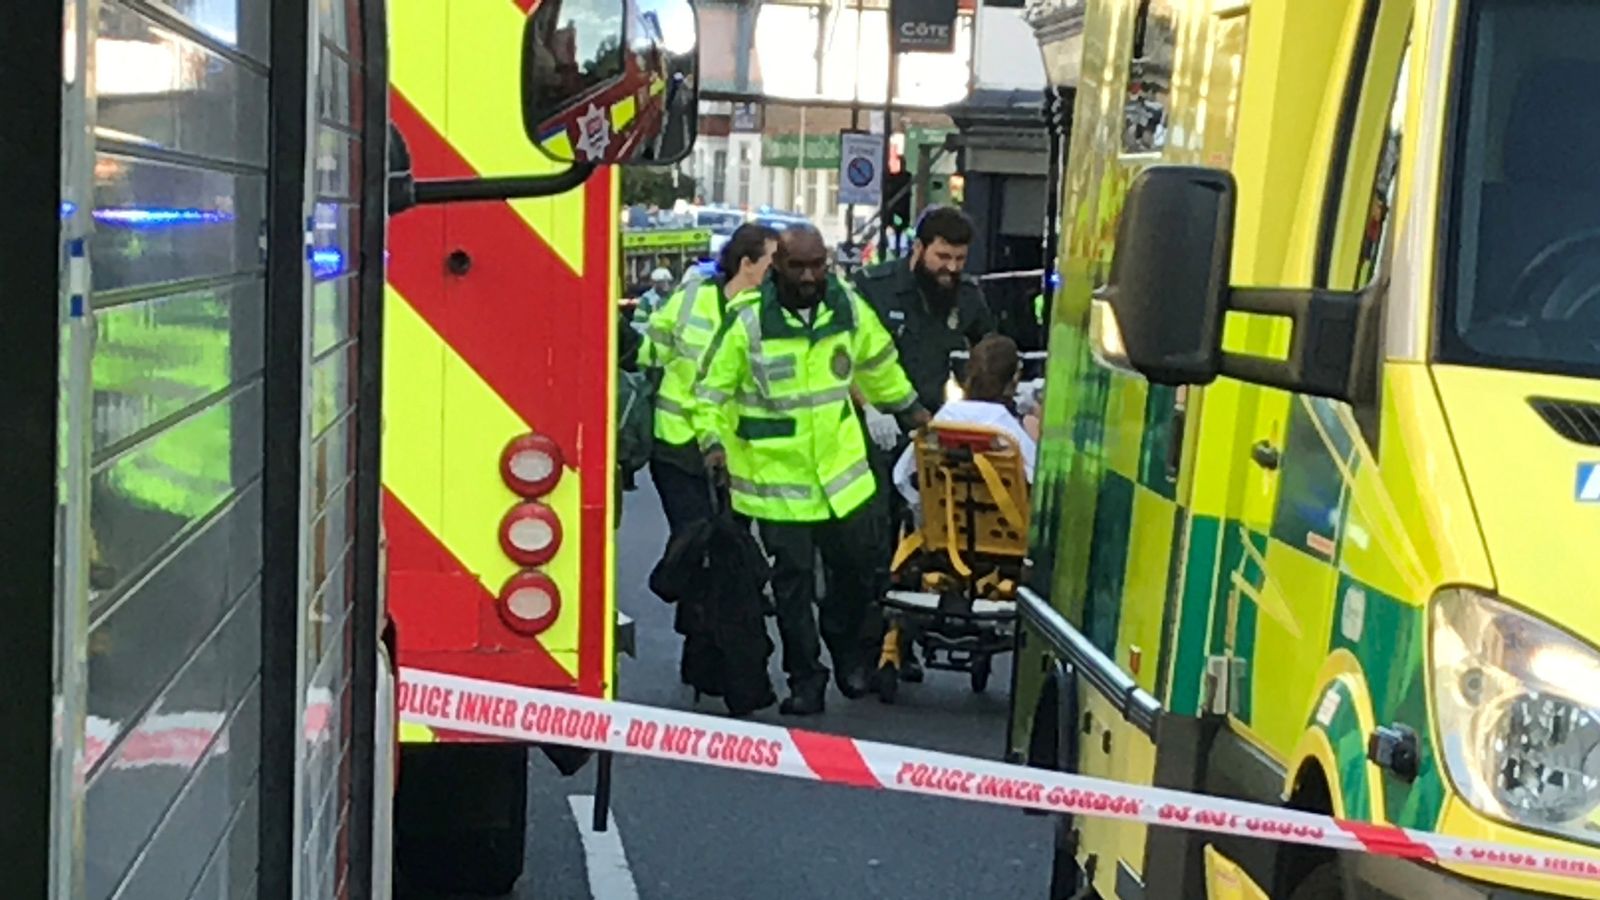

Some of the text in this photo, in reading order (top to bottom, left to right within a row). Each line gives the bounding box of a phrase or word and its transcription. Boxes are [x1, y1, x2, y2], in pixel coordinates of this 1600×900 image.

[397, 681, 454, 719] OLICE
[455, 690, 519, 729] INNER
[520, 701, 612, 744] CORDON
[626, 718, 658, 750] DO
[660, 723, 706, 757] NOT
[707, 731, 782, 768] CROSS
[896, 761, 977, 794] POLICE
